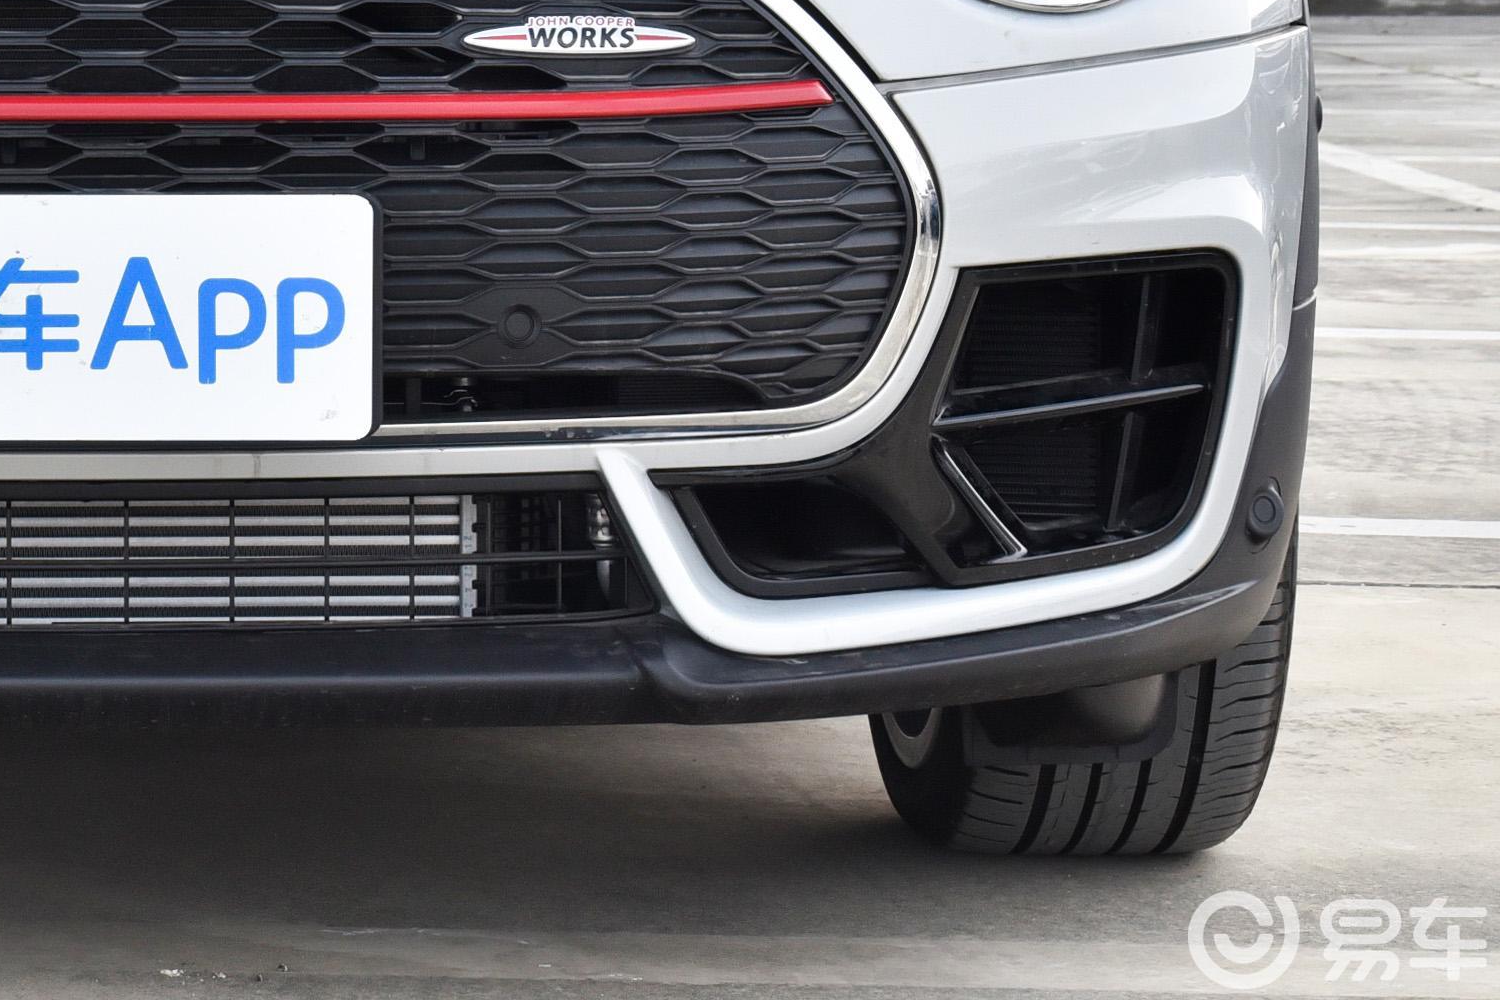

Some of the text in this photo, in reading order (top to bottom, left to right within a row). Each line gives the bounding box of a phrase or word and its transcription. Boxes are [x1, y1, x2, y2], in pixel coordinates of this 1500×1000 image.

[527, 16, 634, 27] JOHN COOPER
[528, 27, 635, 48] WORKS
